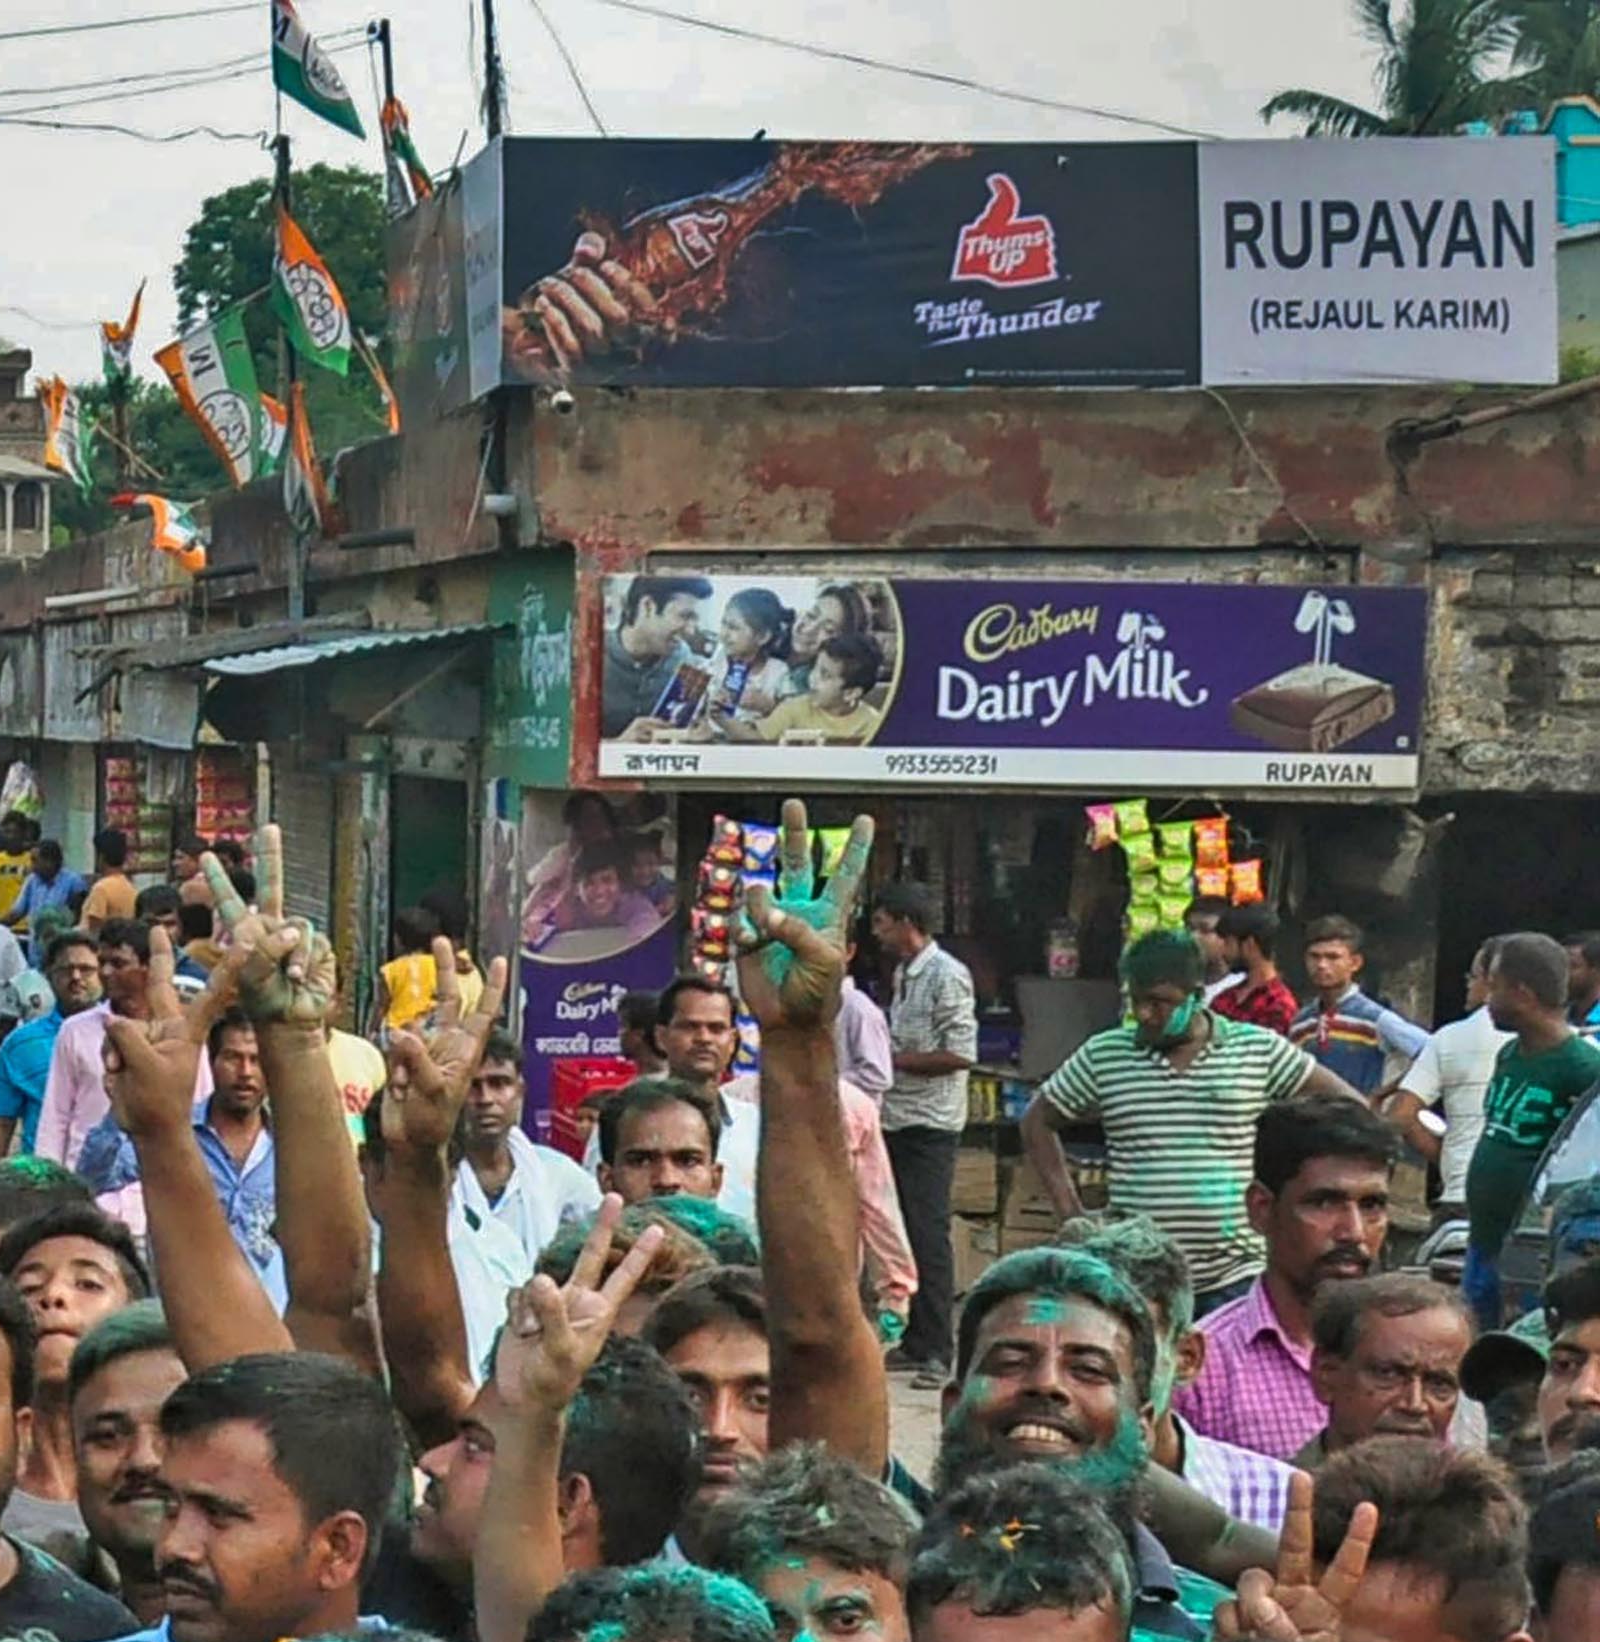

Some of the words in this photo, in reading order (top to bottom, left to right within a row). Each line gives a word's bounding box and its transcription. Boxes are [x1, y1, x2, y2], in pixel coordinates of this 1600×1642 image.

[1224, 199, 1535, 269] RUPAYAN
[913, 299, 983, 324] Taste
[951, 299, 1102, 342] Thunder
[1250, 298, 1384, 334] (REJAUL
[1394, 298, 1510, 334] KARIM)
[964, 603, 1099, 662] Cadbury
[936, 666, 1079, 727] Dairy
[1083, 648, 1209, 707] Milk
[1266, 762, 1373, 783] RUPAYAN
